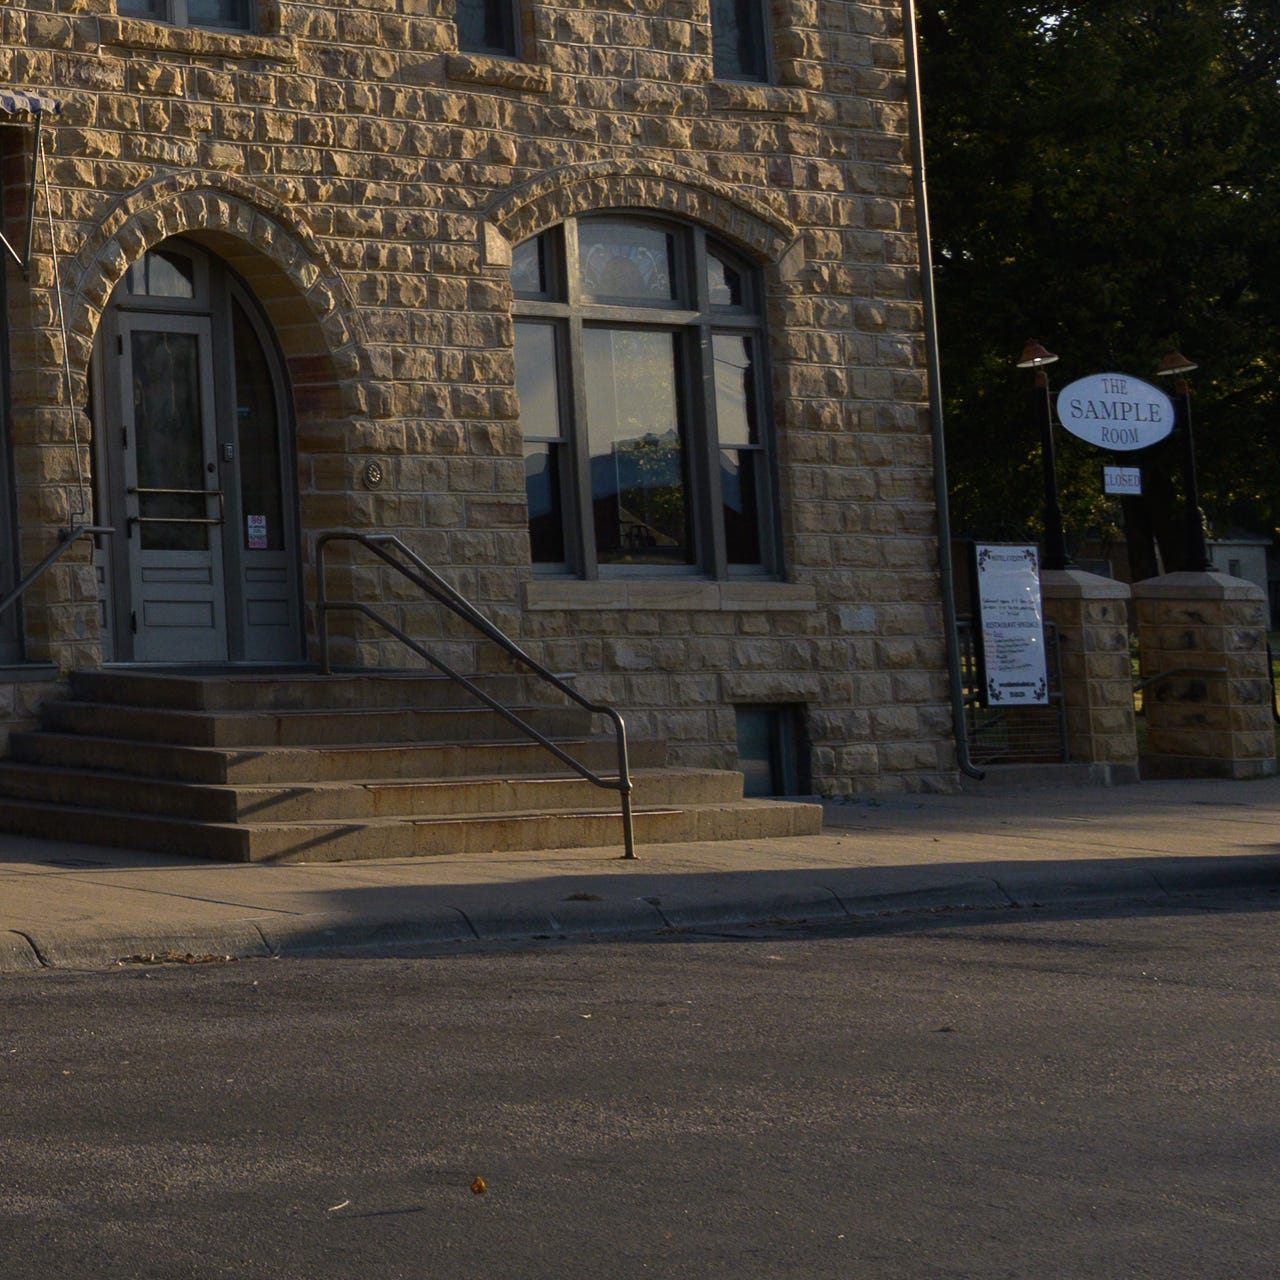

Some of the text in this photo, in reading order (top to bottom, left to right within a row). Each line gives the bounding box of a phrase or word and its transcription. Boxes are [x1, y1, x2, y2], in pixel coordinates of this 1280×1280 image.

[1101, 378, 1128, 395] THE
[1070, 399, 1162, 423] SAMPLE
[1101, 426, 1140, 444] ROOM
[1104, 473, 1140, 487] CLOSED
